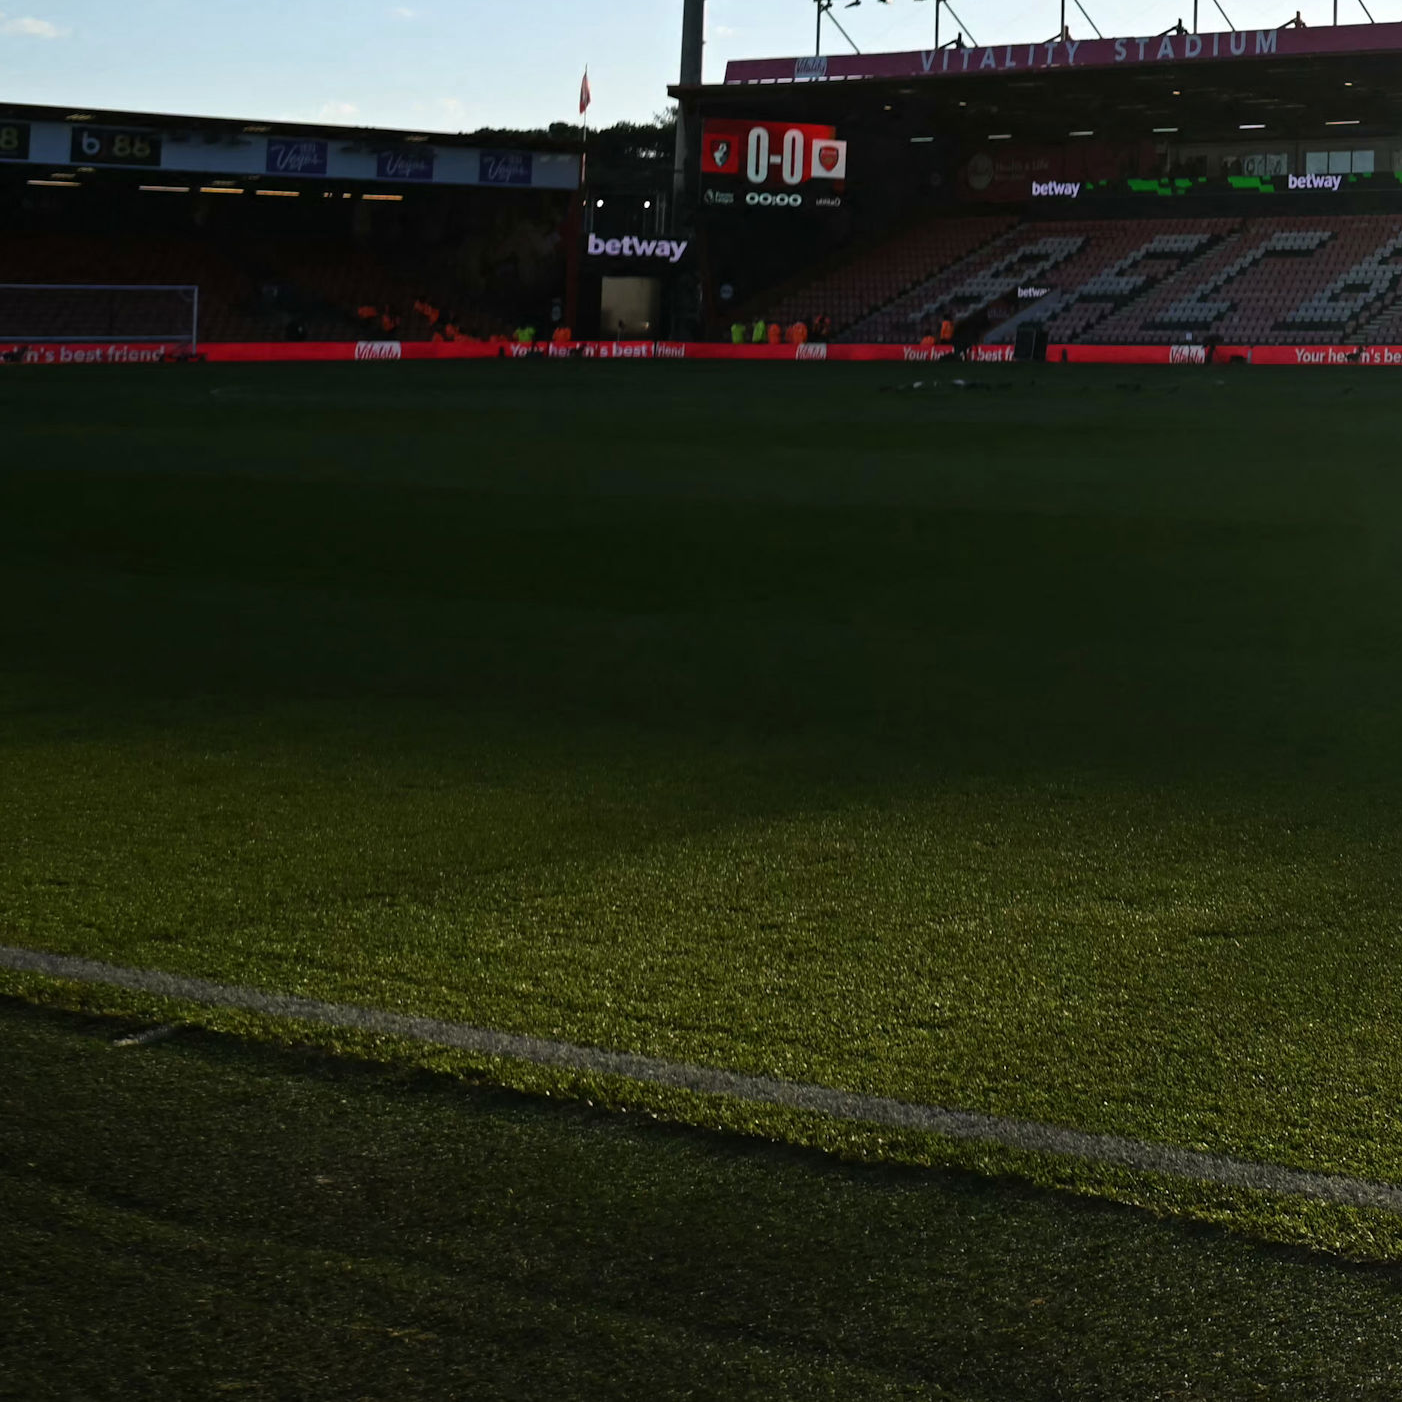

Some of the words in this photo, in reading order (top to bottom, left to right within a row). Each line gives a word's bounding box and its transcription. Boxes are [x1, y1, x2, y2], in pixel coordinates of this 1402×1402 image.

[921, 41, 1080, 72] VITALITY
[1115, 31, 1278, 61] STADIUM
[1032, 181, 1081, 197] betway
[1288, 173, 1342, 191] betway
[746, 192, 803, 207] 00:00
[588, 232, 688, 263] betway
[60, 346, 103, 363] best
[107, 345, 165, 362] friend
[612, 342, 647, 358] best
[903, 347, 929, 361] Your
[1295, 348, 1325, 363] Your
